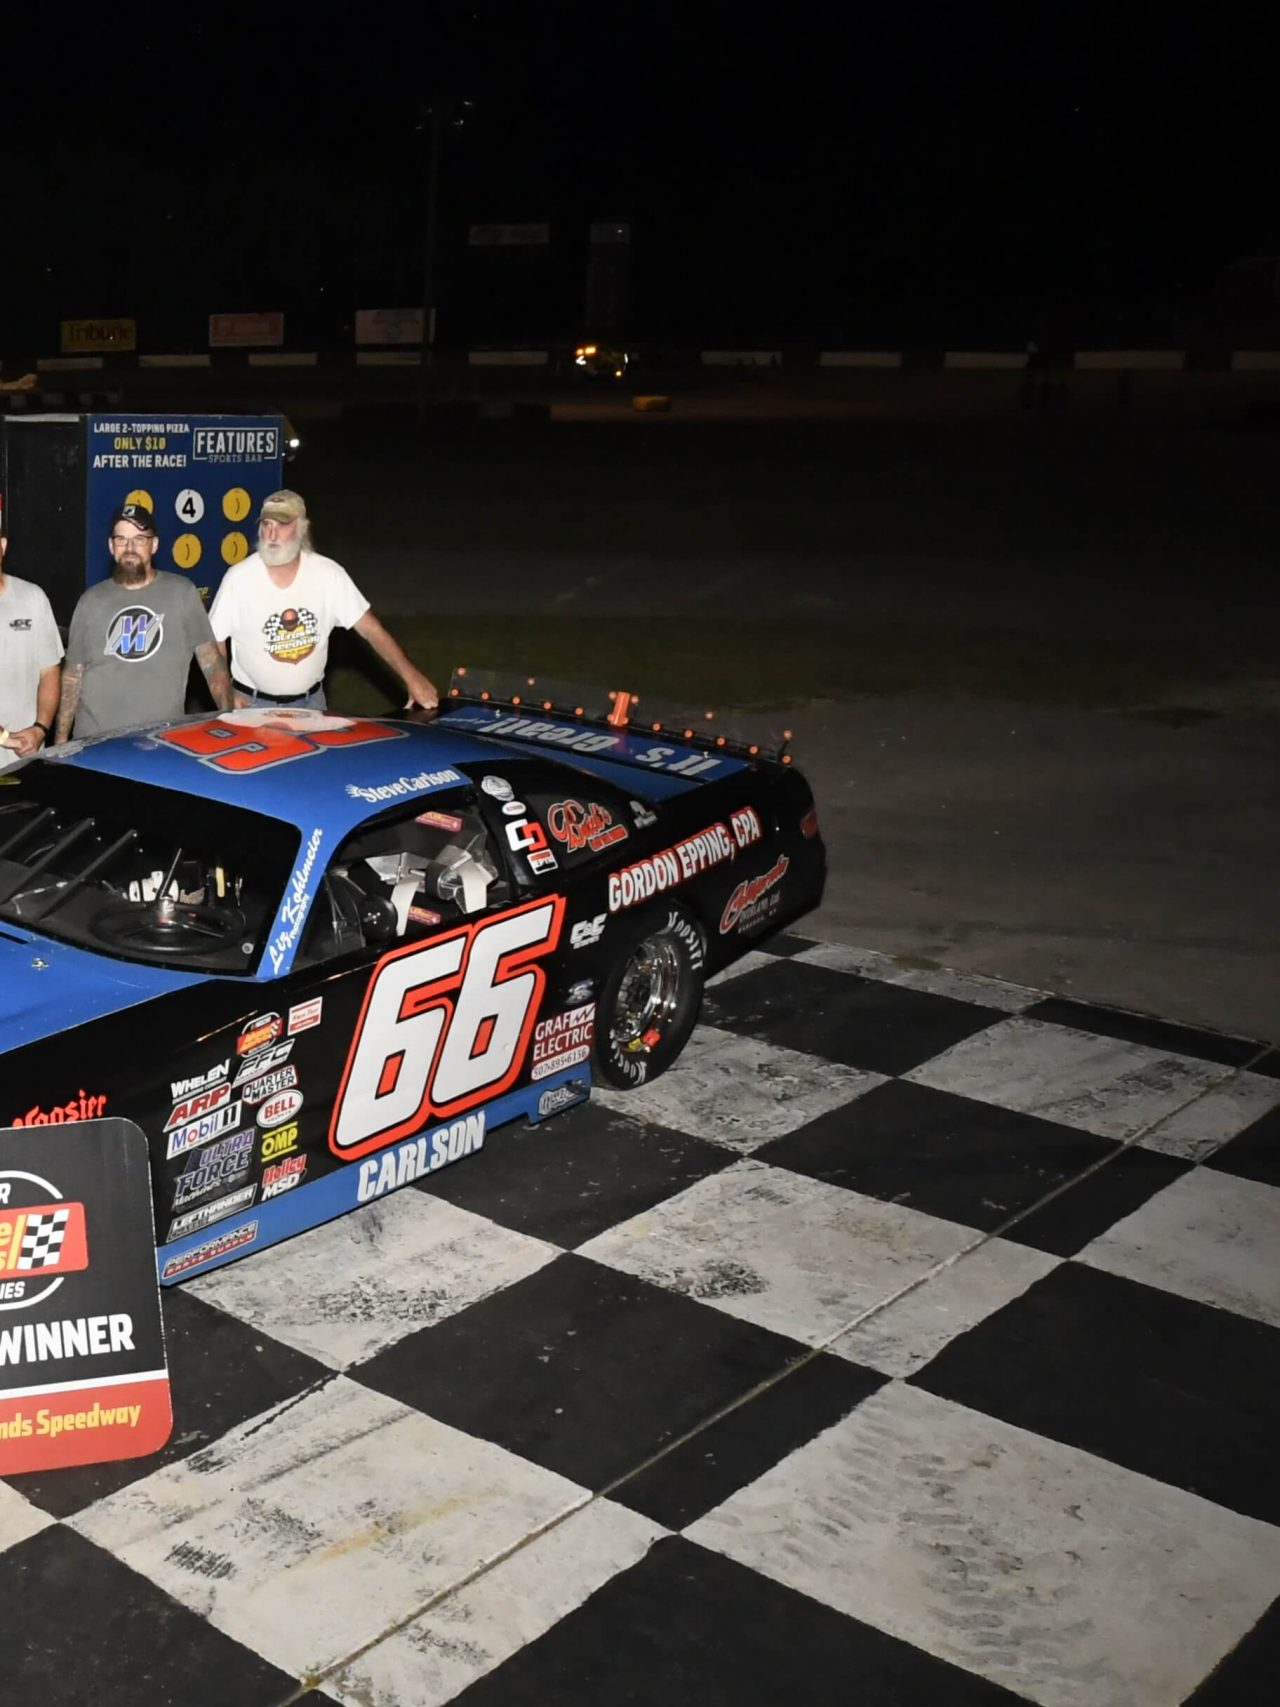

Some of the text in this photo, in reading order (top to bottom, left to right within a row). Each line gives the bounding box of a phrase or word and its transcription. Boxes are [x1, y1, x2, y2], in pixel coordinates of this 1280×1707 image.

[94, 423, 190, 434] LARGE 2-TOPPING PIZZA
[114, 436, 166, 451] ONLY $10
[197, 432, 274, 454] FEATURES
[93, 454, 187, 468] AFTER THE RACE!
[208, 453, 262, 463] SPORTS BAR
[182, 497, 196, 518] 4
[608, 850, 680, 911] GORDON
[679, 825, 735, 878] EPPING,
[731, 809, 761, 848] CPA
[333, 900, 558, 1149] 66
[535, 1012, 572, 1041] GRAF
[533, 1022, 594, 1062] ELECTRIC
[171, 1058, 231, 1098] WHELEN
[244, 1066, 293, 1098] QUARTER
[252, 1074, 296, 1100] MASTER
[170, 1084, 231, 1124] ARP
[264, 1096, 296, 1119] BELL
[172, 1120, 220, 1150] Mobil
[223, 1103, 237, 1126] 1
[261, 1127, 298, 1156] OMP
[199, 1127, 256, 1168] ULTRA
[357, 1110, 486, 1202] CARLSON
[175, 1148, 253, 1198] FORCE
[263, 1154, 307, 1187] Holley
[261, 1173, 300, 1201] MSD
[167, 1222, 256, 1266] PERFORMANCE
[36, 1404, 142, 1436] Speedway
